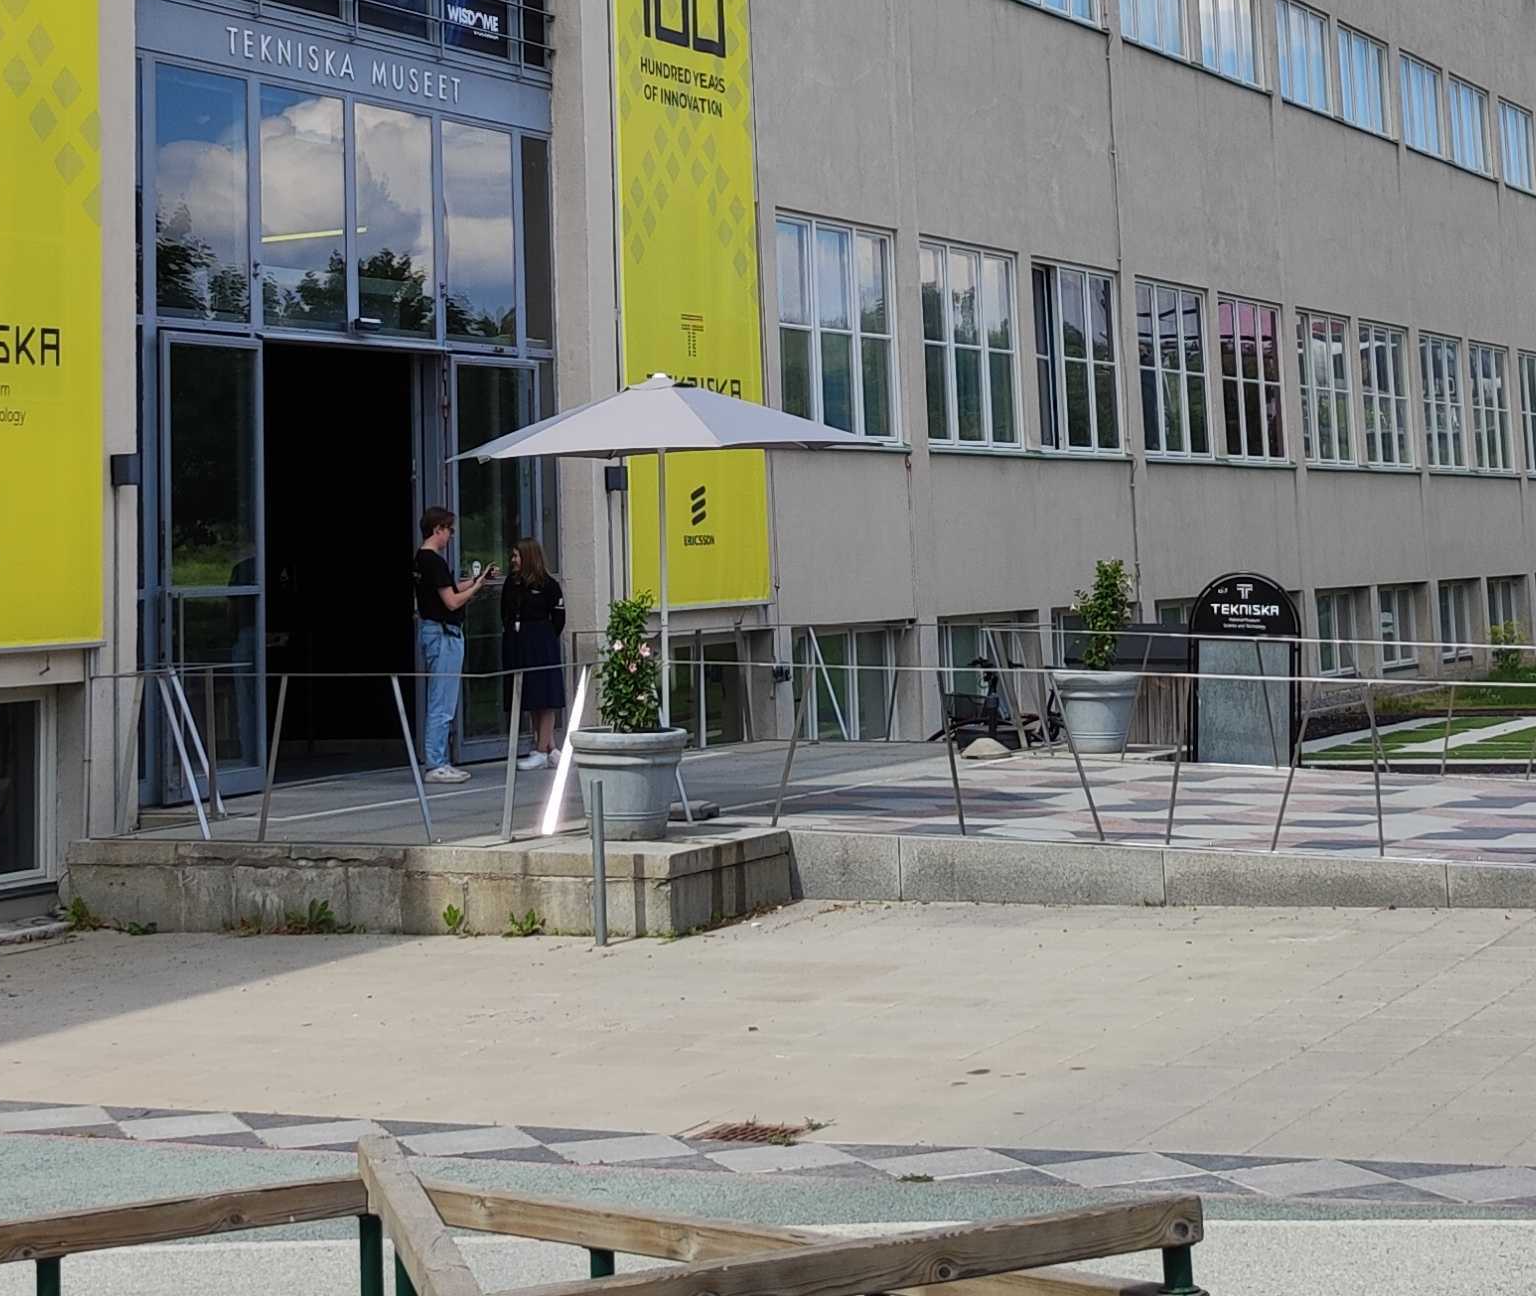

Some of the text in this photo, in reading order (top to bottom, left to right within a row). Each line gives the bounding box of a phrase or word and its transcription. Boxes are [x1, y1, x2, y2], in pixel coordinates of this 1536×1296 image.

[226, 26, 462, 104] TEKNISKA MUSEET
[640, 56, 726, 94] HUNDRED YEARS
[643, 84, 723, 118] OF INNOVATION
[1210, 603, 1280, 616] TEKNISKA
